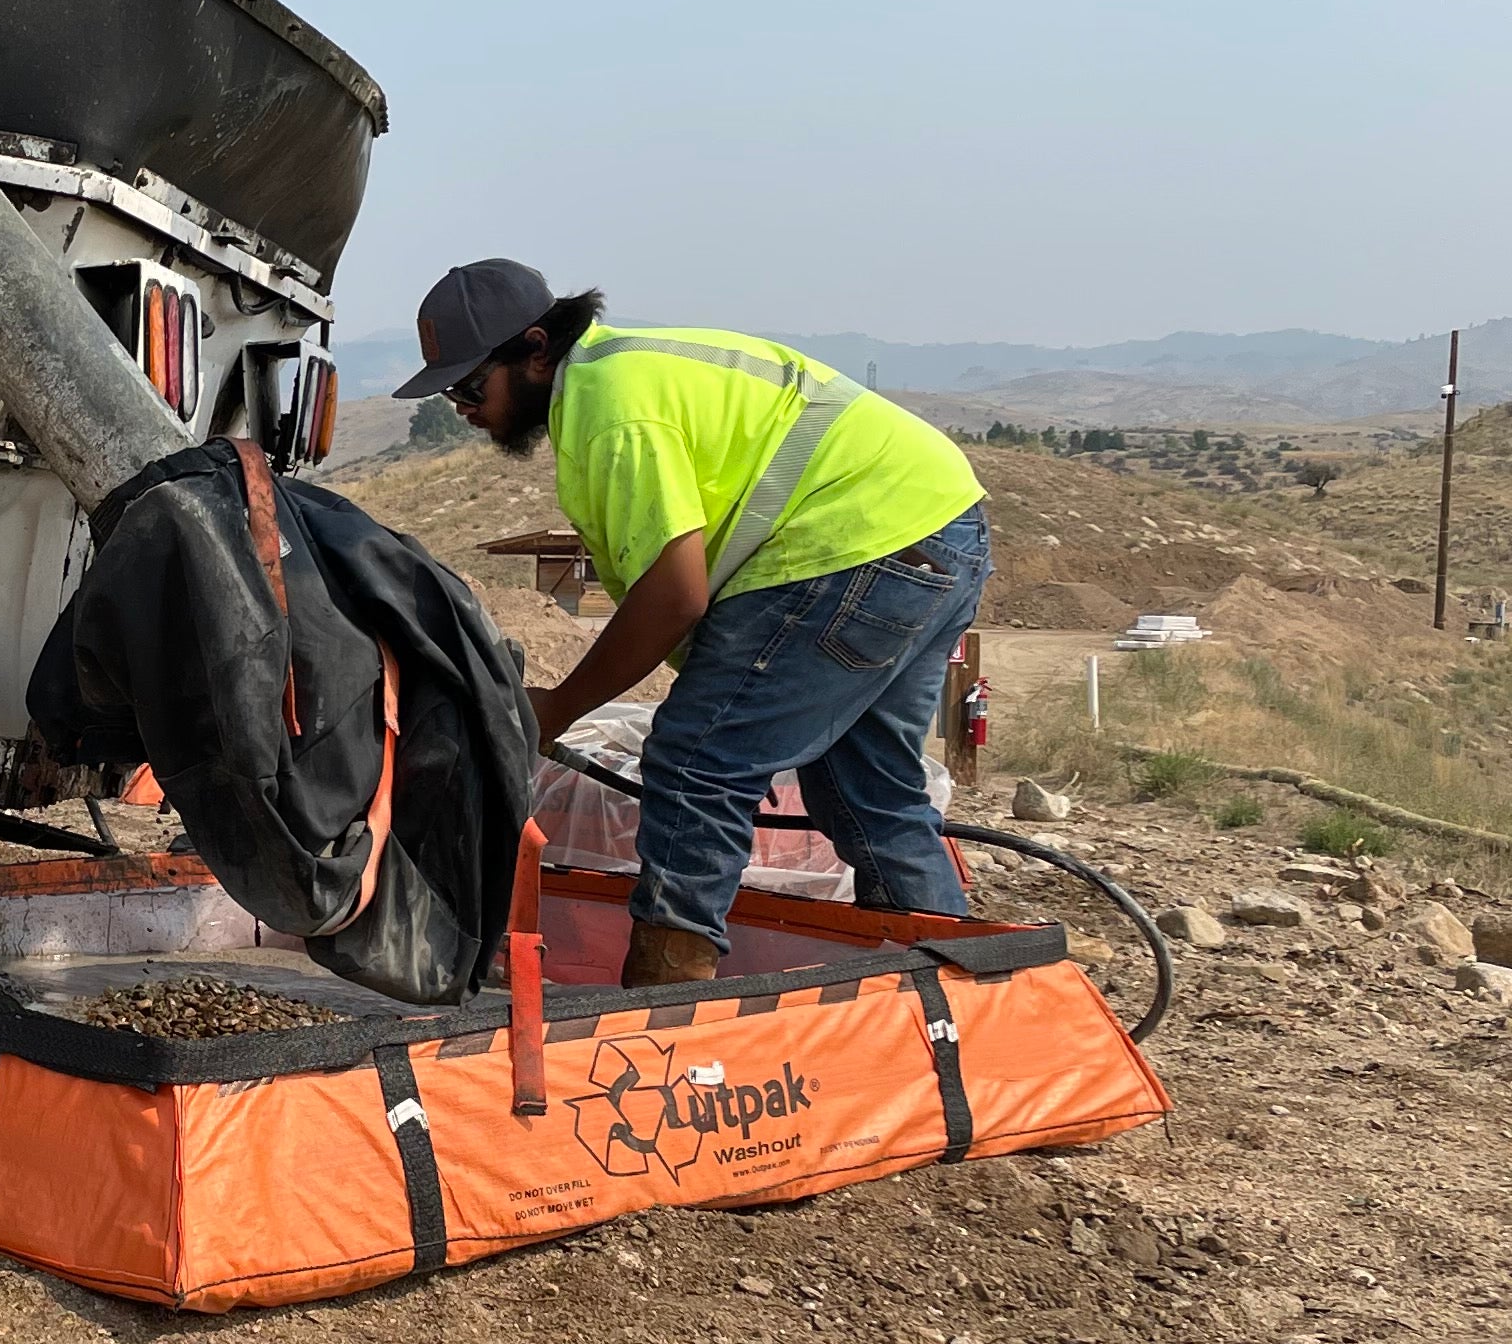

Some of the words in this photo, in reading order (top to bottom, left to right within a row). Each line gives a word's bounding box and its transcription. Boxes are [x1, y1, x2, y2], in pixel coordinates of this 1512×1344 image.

[713, 1132, 802, 1165] Washout
[508, 1191, 523, 1202] DO
[524, 1187, 544, 1198] NOT
[546, 1182, 571, 1196] OVER
[515, 1210, 527, 1221] DO
[527, 1205, 545, 1217] NOT
[547, 1201, 574, 1214] MOVE
[574, 1196, 594, 1208] WET
